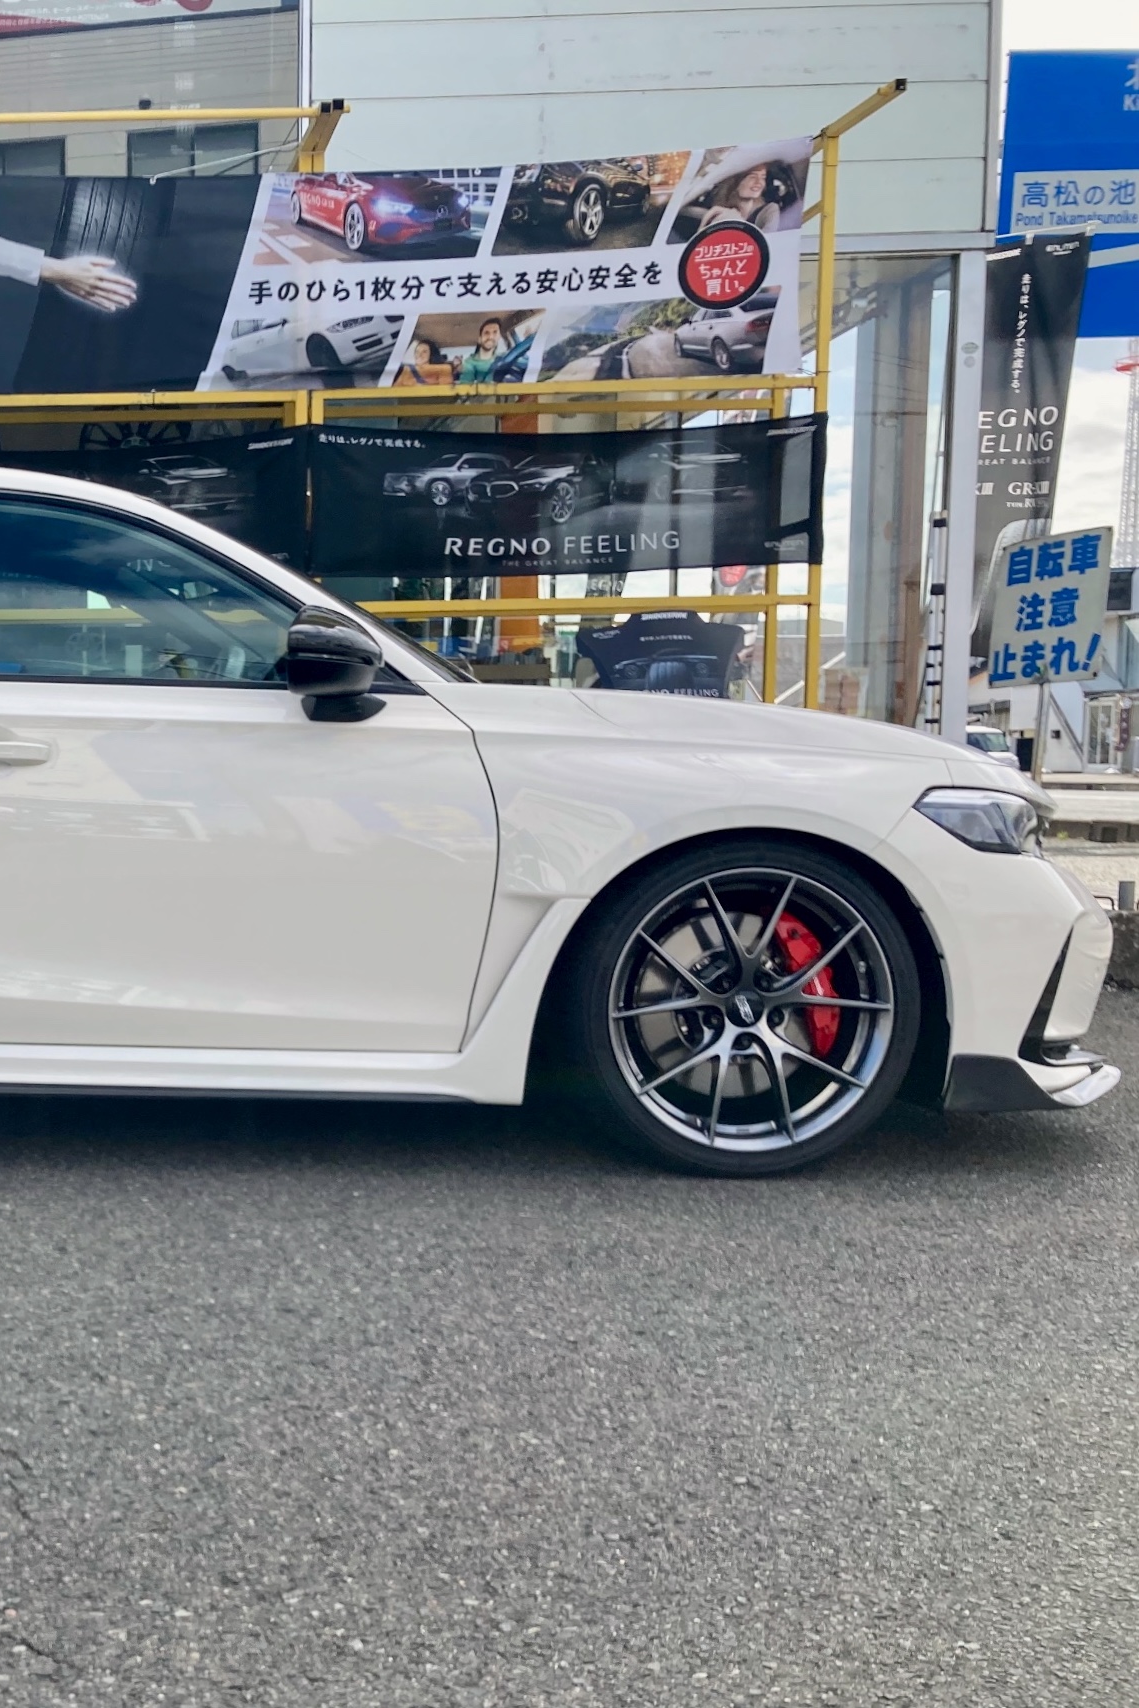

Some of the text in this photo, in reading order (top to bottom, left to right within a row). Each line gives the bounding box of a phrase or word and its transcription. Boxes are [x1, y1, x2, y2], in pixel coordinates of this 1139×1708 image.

[1021, 179, 1137, 208] 高松の池
[1016, 212, 1044, 226] Pond
[698, 259, 748, 279] ちゃんと
[248, 261, 662, 305] 手のひら1枚分で支える安心安全を
[705, 278, 746, 297] 買い。
[977, 406, 1059, 429] EGNO
[980, 430, 1055, 454] ELING
[977, 458, 1006, 466] REAT
[444, 531, 680, 557] REGNO FEELING
[525, 559, 558, 567] GREAT
[1006, 534, 1102, 587] 自転車
[1016, 588, 1080, 632] 注意
